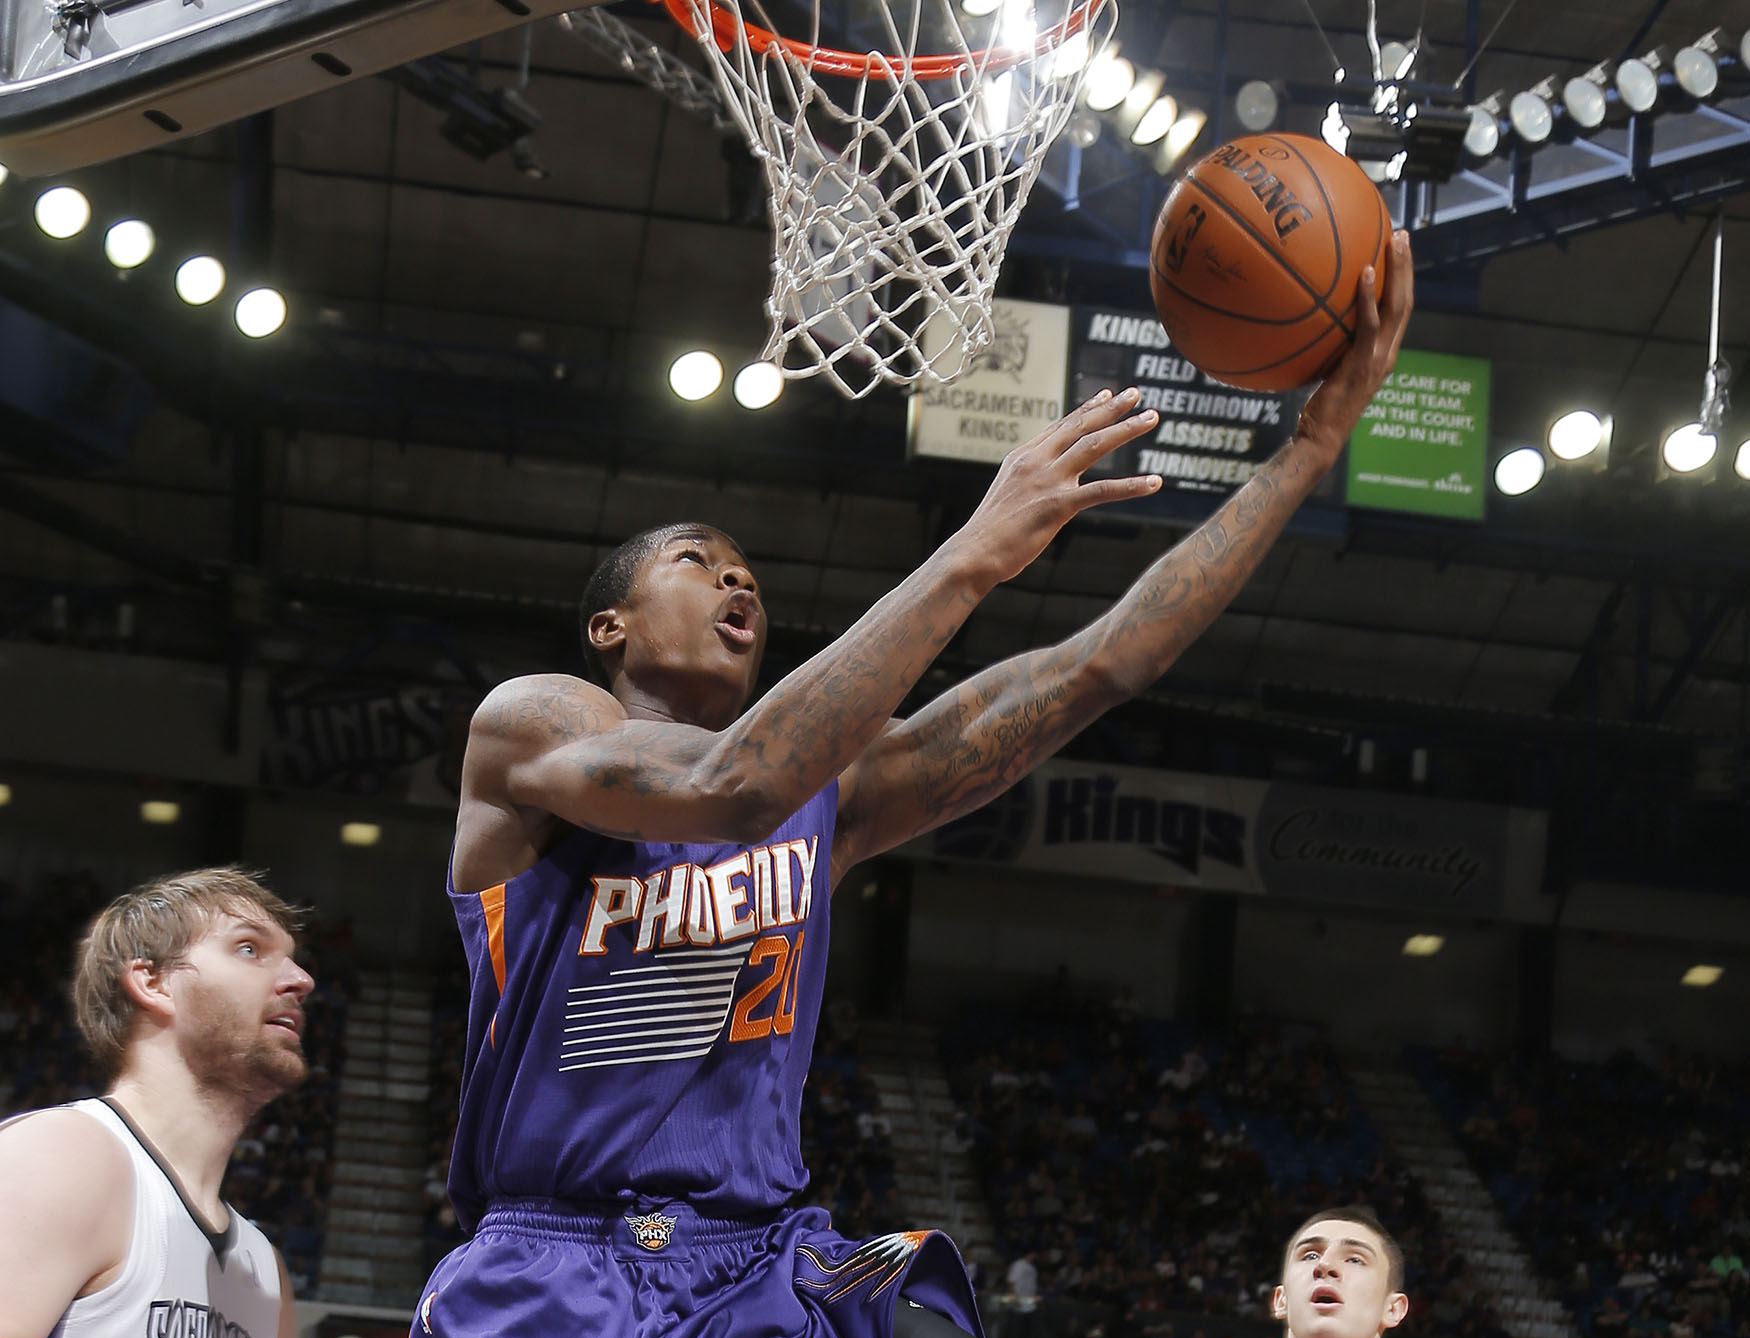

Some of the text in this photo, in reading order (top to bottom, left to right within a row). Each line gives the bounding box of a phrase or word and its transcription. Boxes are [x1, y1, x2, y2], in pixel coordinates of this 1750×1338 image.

[1087, 313, 1170, 349] KINGS
[1135, 353, 1197, 383] FIELD
[1397, 374, 1437, 392] CARE
[1440, 379, 1473, 395] FOR
[924, 385, 1060, 421] SACRAMENTO
[1135, 385, 1282, 426] FREETHROW%
[1373, 388, 1465, 411] YOUR TEAM.
[959, 416, 1020, 443] KINGS
[1370, 422, 1464, 447] AND IN LIFE.
[1390, 407, 1419, 424] THE
[1422, 410, 1475, 432] COURT,
[1156, 420, 1252, 454] ASSISTS
[1043, 774, 1247, 877] Kings
[1269, 809, 1483, 897] Community
[578, 835, 819, 956] PHOENIX
[728, 929, 805, 1042] 20
[639, 1228, 668, 1241] PHX
